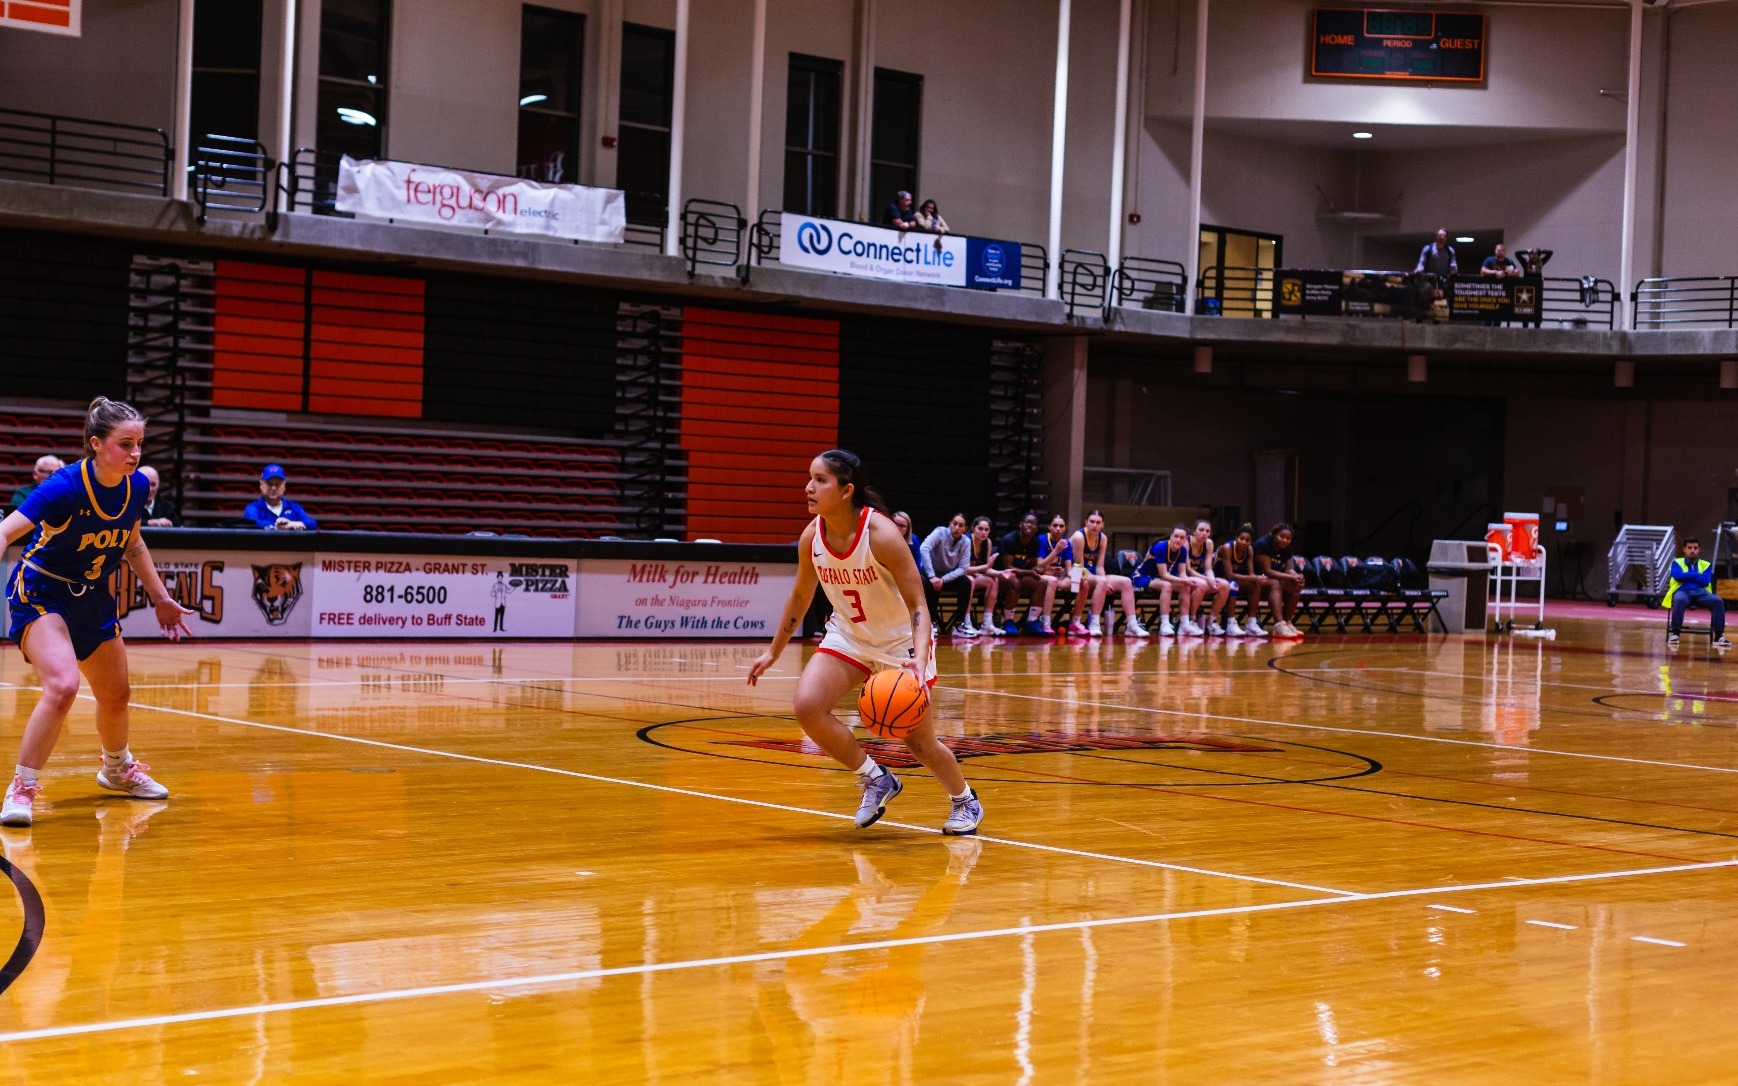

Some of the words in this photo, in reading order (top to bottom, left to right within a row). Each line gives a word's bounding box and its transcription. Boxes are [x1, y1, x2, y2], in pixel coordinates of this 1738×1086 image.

[1320, 34, 1355, 46] HOME
[1383, 39, 1413, 48] PERIOD
[1439, 38, 1480, 49] GUEST
[404, 167, 519, 220] ferguson
[519, 207, 560, 221] electric
[875, 264, 895, 275] Organ
[77, 528, 131, 552] POLY
[84, 554, 107, 580] 3
[321, 560, 371, 573] MISTER
[375, 561, 412, 574] PIZZA
[423, 563, 468, 575] GRANT
[470, 563, 489, 576] ST.
[508, 562, 570, 578] MISTER
[853, 565, 879, 586] STATE
[626, 563, 668, 584] Milk
[669, 565, 700, 589] for
[702, 565, 760, 585] Health
[522, 578, 570, 593] PIZZA
[363, 584, 448, 605] 881-6500
[634, 597, 648, 608] on
[650, 594, 666, 608] the
[668, 595, 708, 611] Niagara
[709, 596, 751, 608] Frontier
[842, 589, 867, 624] 3
[319, 612, 354, 626] FREE
[358, 612, 408, 629] delivery
[410, 614, 424, 626] to
[426, 613, 452, 627] Buff
[455, 614, 486, 627] State
[616, 615, 641, 630] The
[643, 615, 676, 633] Guys
[679, 615, 709, 630] With
[710, 615, 733, 630] the
[733, 616, 766, 630] Cows
